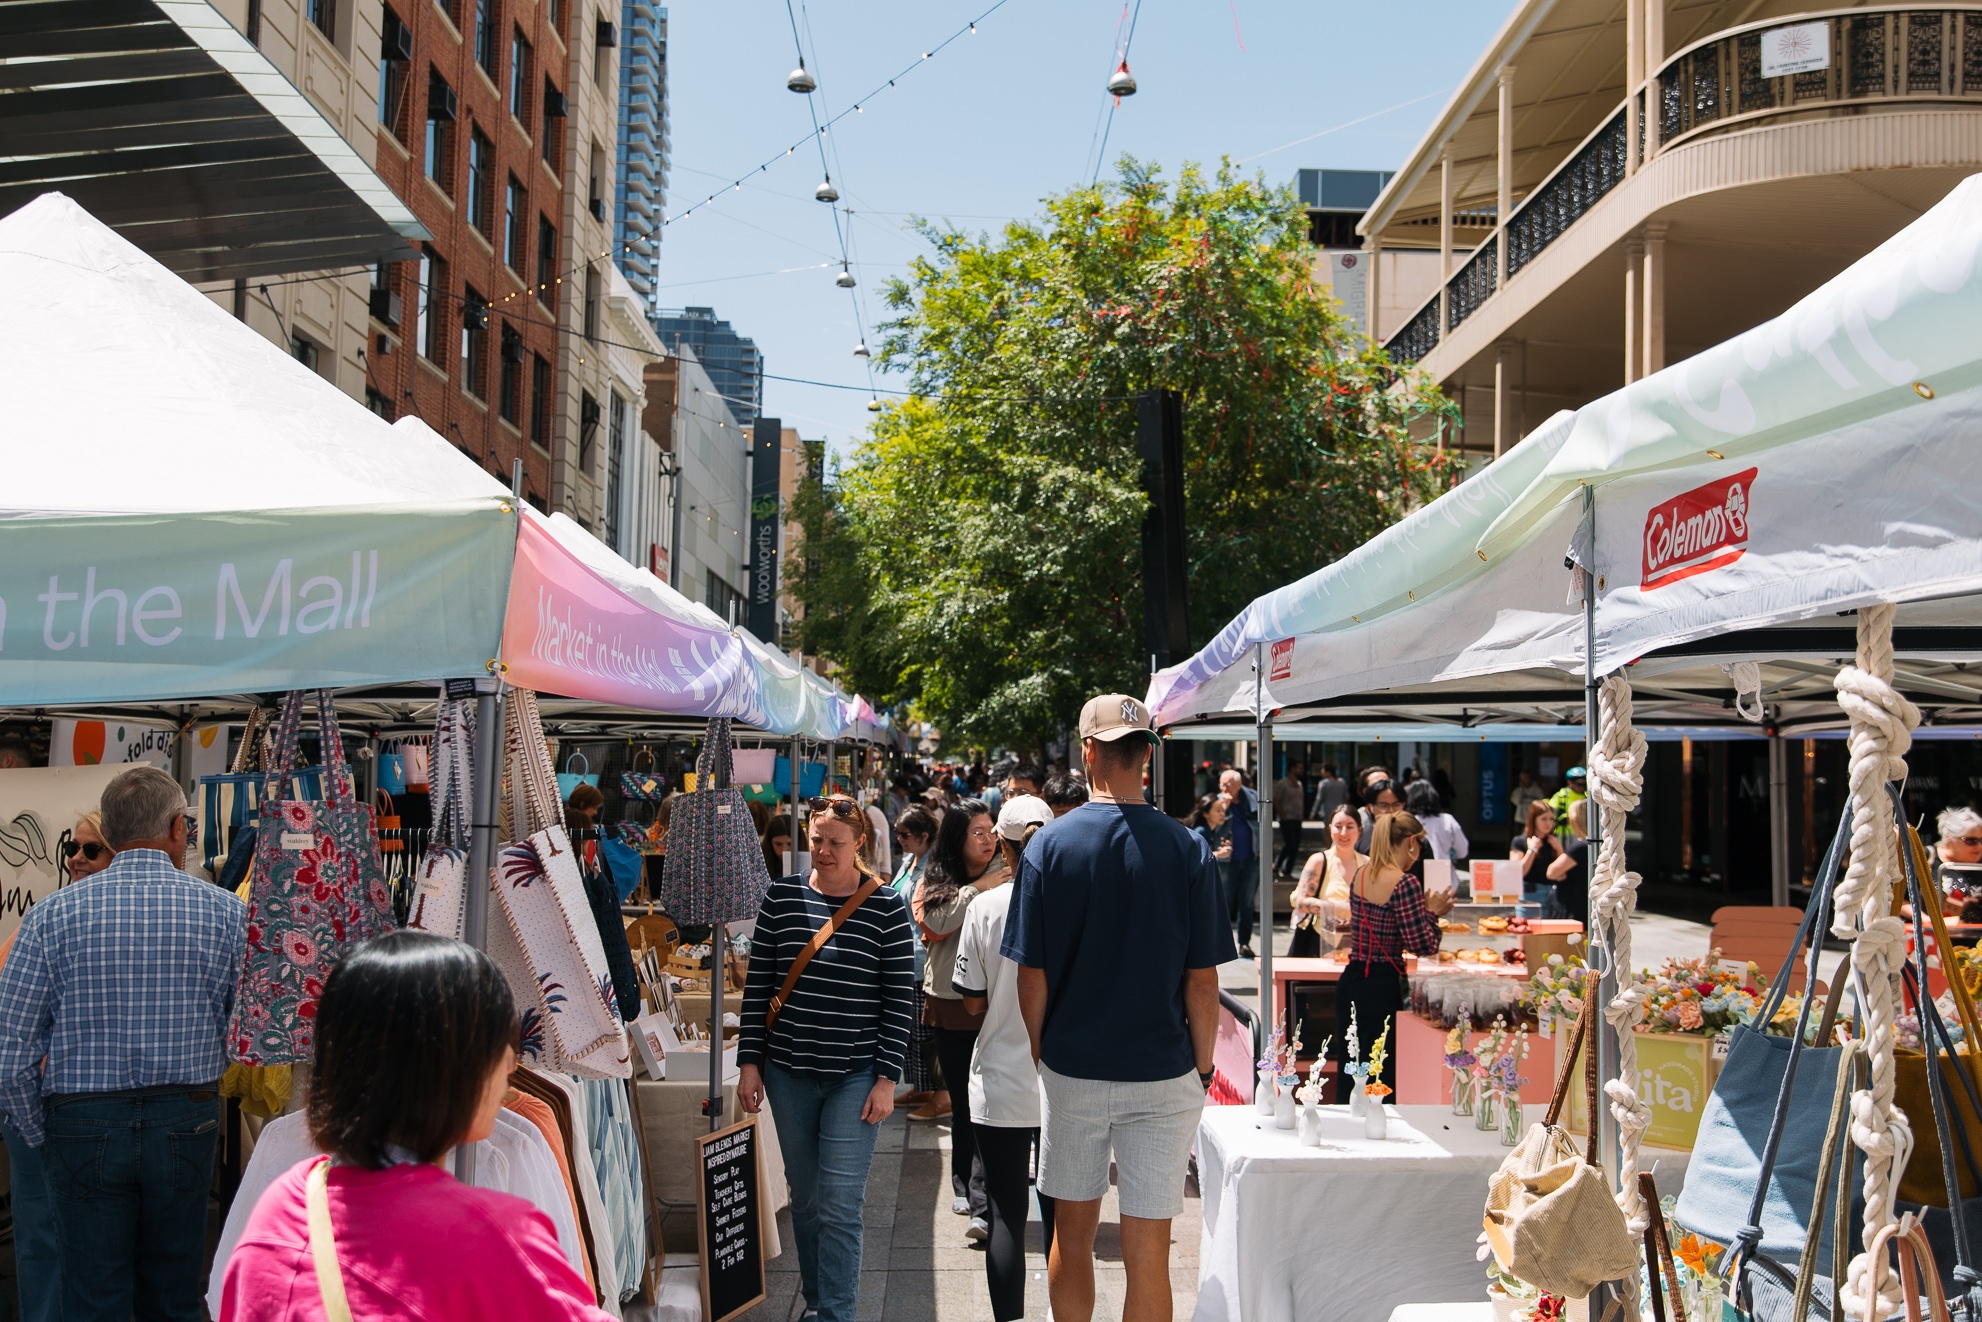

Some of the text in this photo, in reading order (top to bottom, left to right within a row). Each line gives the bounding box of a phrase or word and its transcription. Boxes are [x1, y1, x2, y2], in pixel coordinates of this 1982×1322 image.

[1647, 505, 1727, 570] Coleman
[37, 566, 183, 651] the
[215, 550, 378, 641] Mall
[531, 585, 604, 678] Market
[610, 634, 642, 688] the
[1121, 701, 1139, 722] NY
[128, 728, 154, 763] fold
[1482, 769, 1495, 820] OPTUS
[1658, 1061, 1700, 1102] HANDMADE STUDIO
[707, 1143, 747, 1170] INSPIRED BY NATURE
[715, 1137, 732, 1153] BLENDS
[733, 1129, 751, 1145] MARKET
[721, 1259, 726, 1270] 2
[736, 1249, 745, 1262] $12
